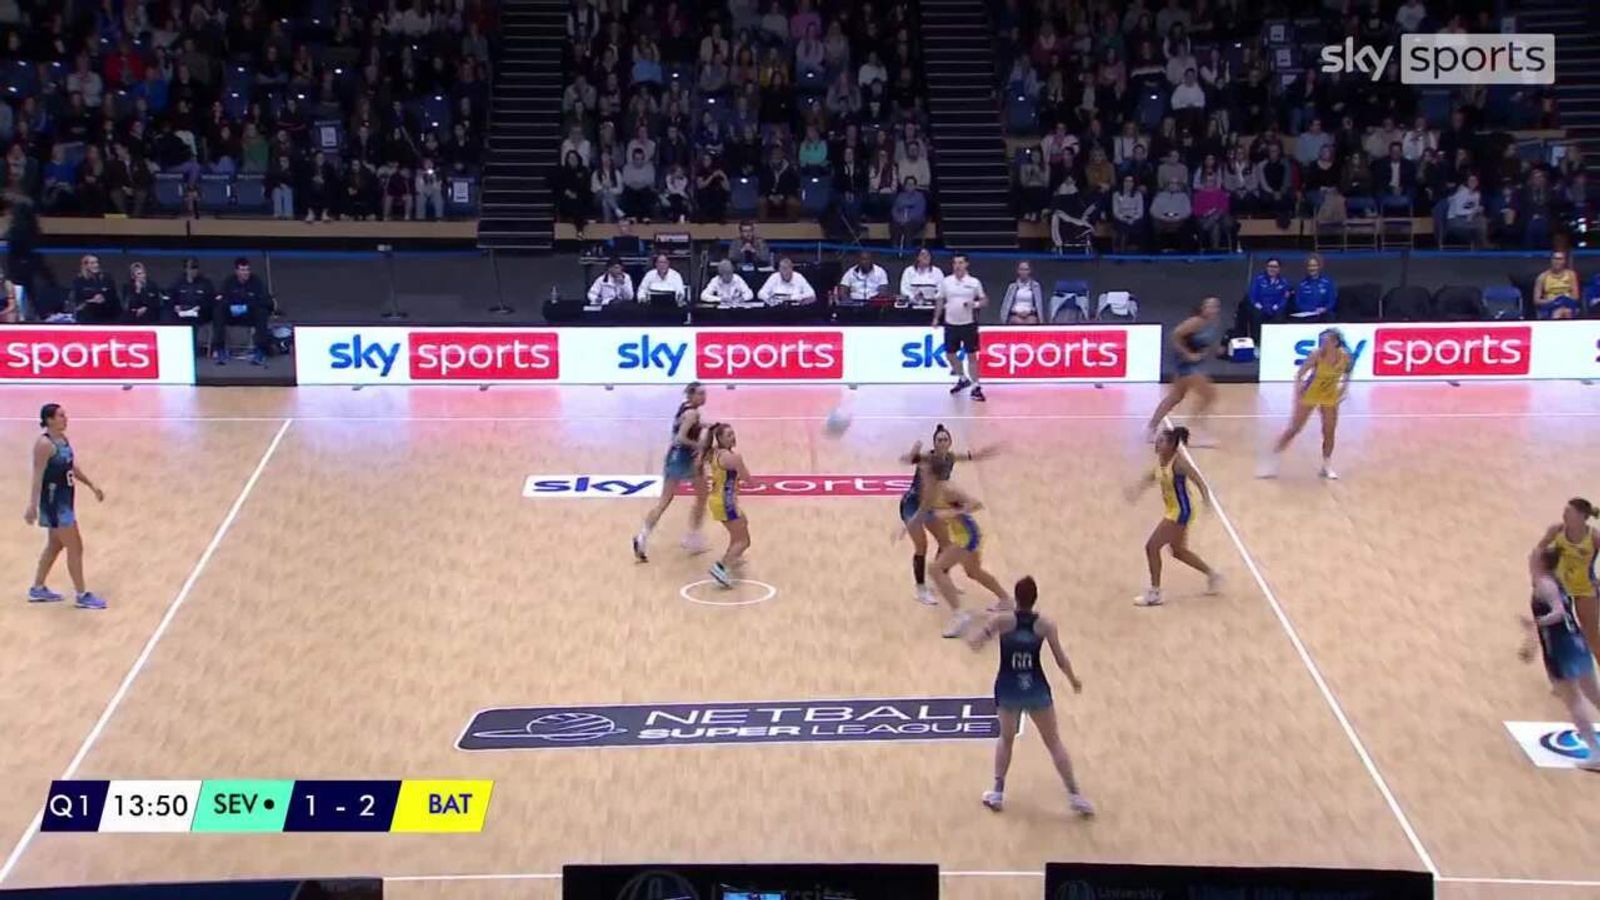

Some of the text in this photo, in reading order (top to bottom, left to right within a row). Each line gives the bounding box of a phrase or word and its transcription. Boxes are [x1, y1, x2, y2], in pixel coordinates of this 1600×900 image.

[6, 336, 150, 373] sports
[329, 334, 550, 376] sky sports
[617, 334, 836, 376] sky sports
[987, 337, 1119, 374] sports
[1382, 336, 1522, 371] sports
[533, 476, 656, 495] sky
[637, 722, 992, 739] SUPER LEAGUE
[645, 704, 1000, 726] NETBALL
